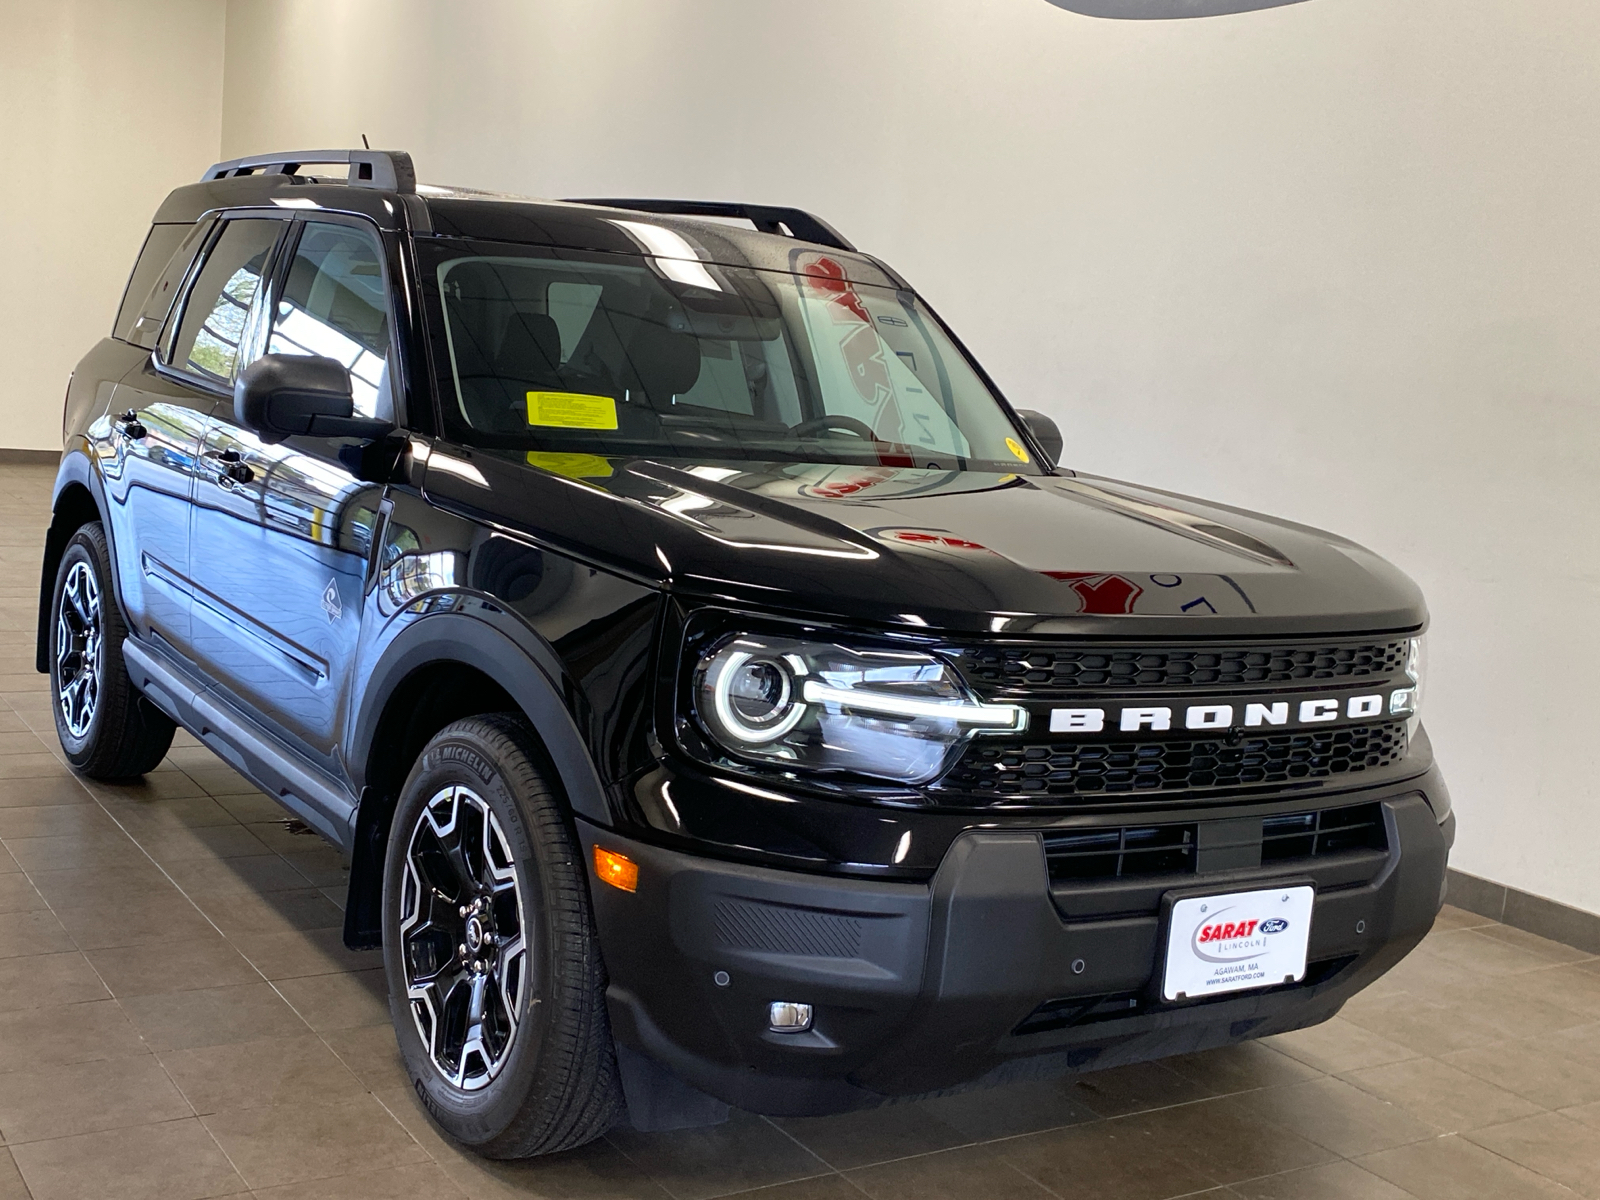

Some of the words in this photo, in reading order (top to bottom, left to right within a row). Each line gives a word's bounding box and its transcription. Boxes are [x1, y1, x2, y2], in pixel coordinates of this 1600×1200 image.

[1049, 694, 1383, 732] BRONCO
[442, 747, 493, 780] MICHELIN
[1198, 919, 1259, 944] SARAT
[1263, 919, 1284, 933] Ford
[1224, 940, 1260, 951] LINCOLN
[1206, 972, 1265, 986] WWW.SARATFORD.COM
[1213, 964, 1247, 976] AGAWAM,
[1248, 963, 1259, 971] MA
